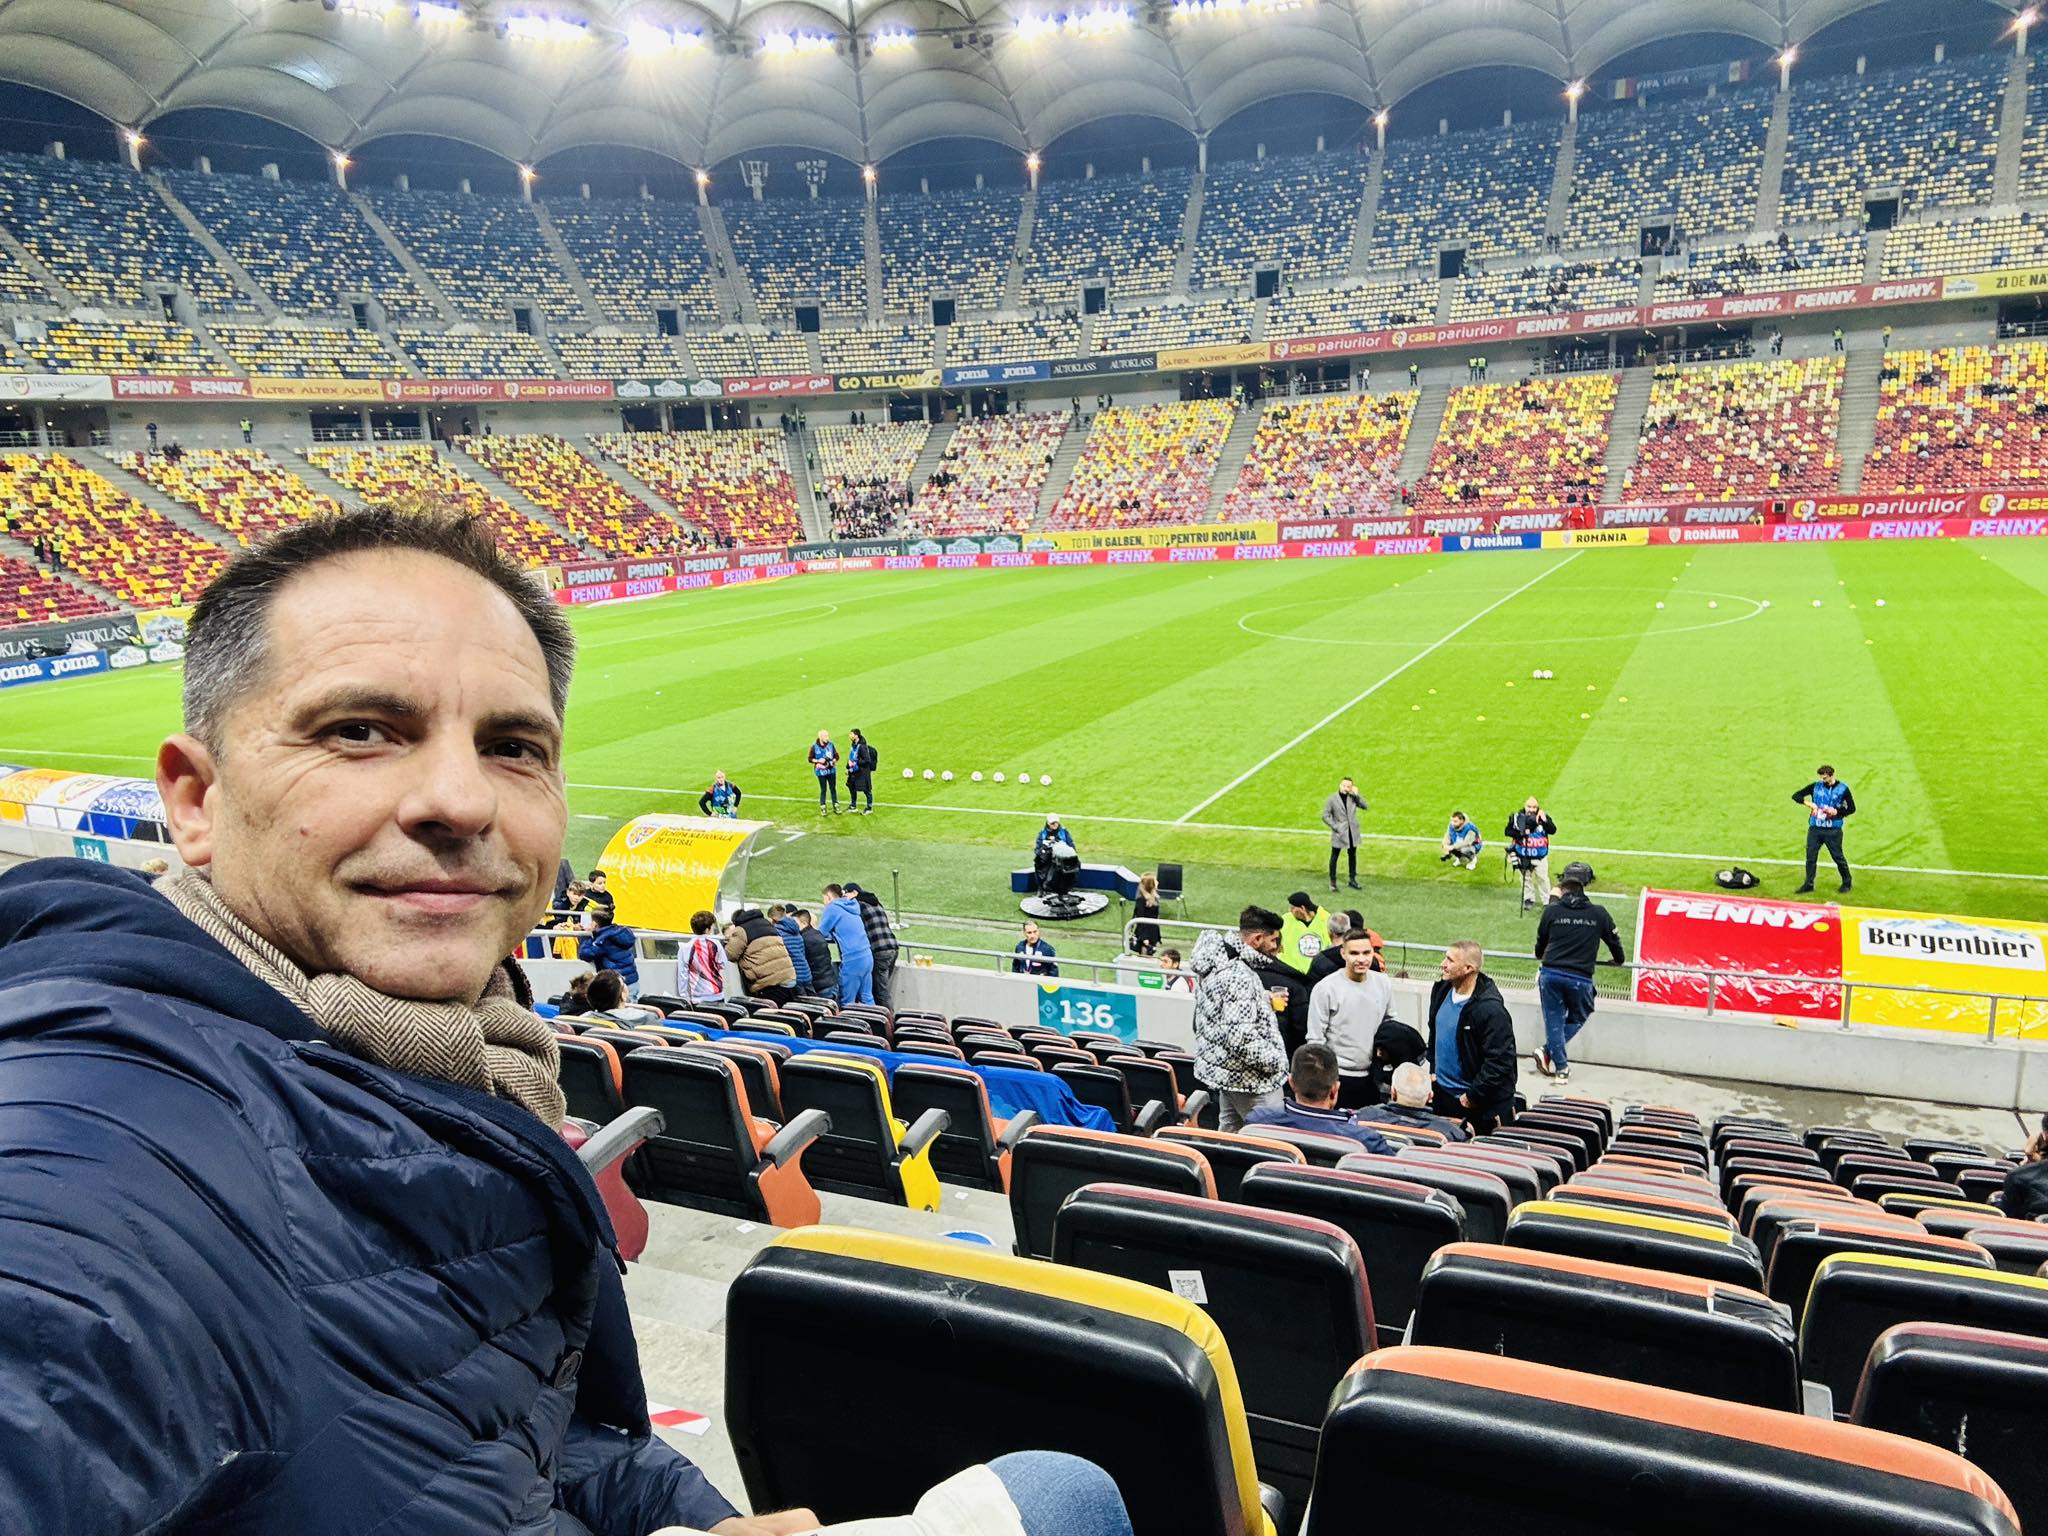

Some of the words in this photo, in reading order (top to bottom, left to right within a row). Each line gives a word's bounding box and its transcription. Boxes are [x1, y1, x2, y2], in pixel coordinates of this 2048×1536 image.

[1996, 277, 2008, 289] ZI
[2011, 275, 2027, 287] DE
[2029, 273, 2048, 286] NA
[1408, 330, 1436, 344] casa
[1437, 324, 1505, 344] pariurilor
[1289, 341, 1316, 355] casa
[1317, 334, 1382, 355] pariurilor
[403, 386, 430, 395] casa
[432, 384, 494, 396] pariurilor
[838, 377, 860, 390] GO
[862, 374, 920, 388] YELLOW
[519, 385, 547, 396] casa
[548, 383, 608, 398] pariurilor
[1817, 503, 1860, 516] casa
[1861, 499, 1966, 518] pariurilor
[1171, 532, 1209, 543] PENTRU
[1212, 528, 1257, 541] ROMÂNIA
[1473, 535, 1523, 548] ROMÂNIA
[1683, 527, 1740, 541] ROMÂNIA
[793, 549, 837, 561] AUTOKASS
[80, 845, 100, 861] 134
[1554, 917, 1571, 925] AIR
[1573, 918, 1598, 927] MAX
[1867, 926, 2036, 959] Bergenbier
[1059, 999, 1115, 1029] 136
